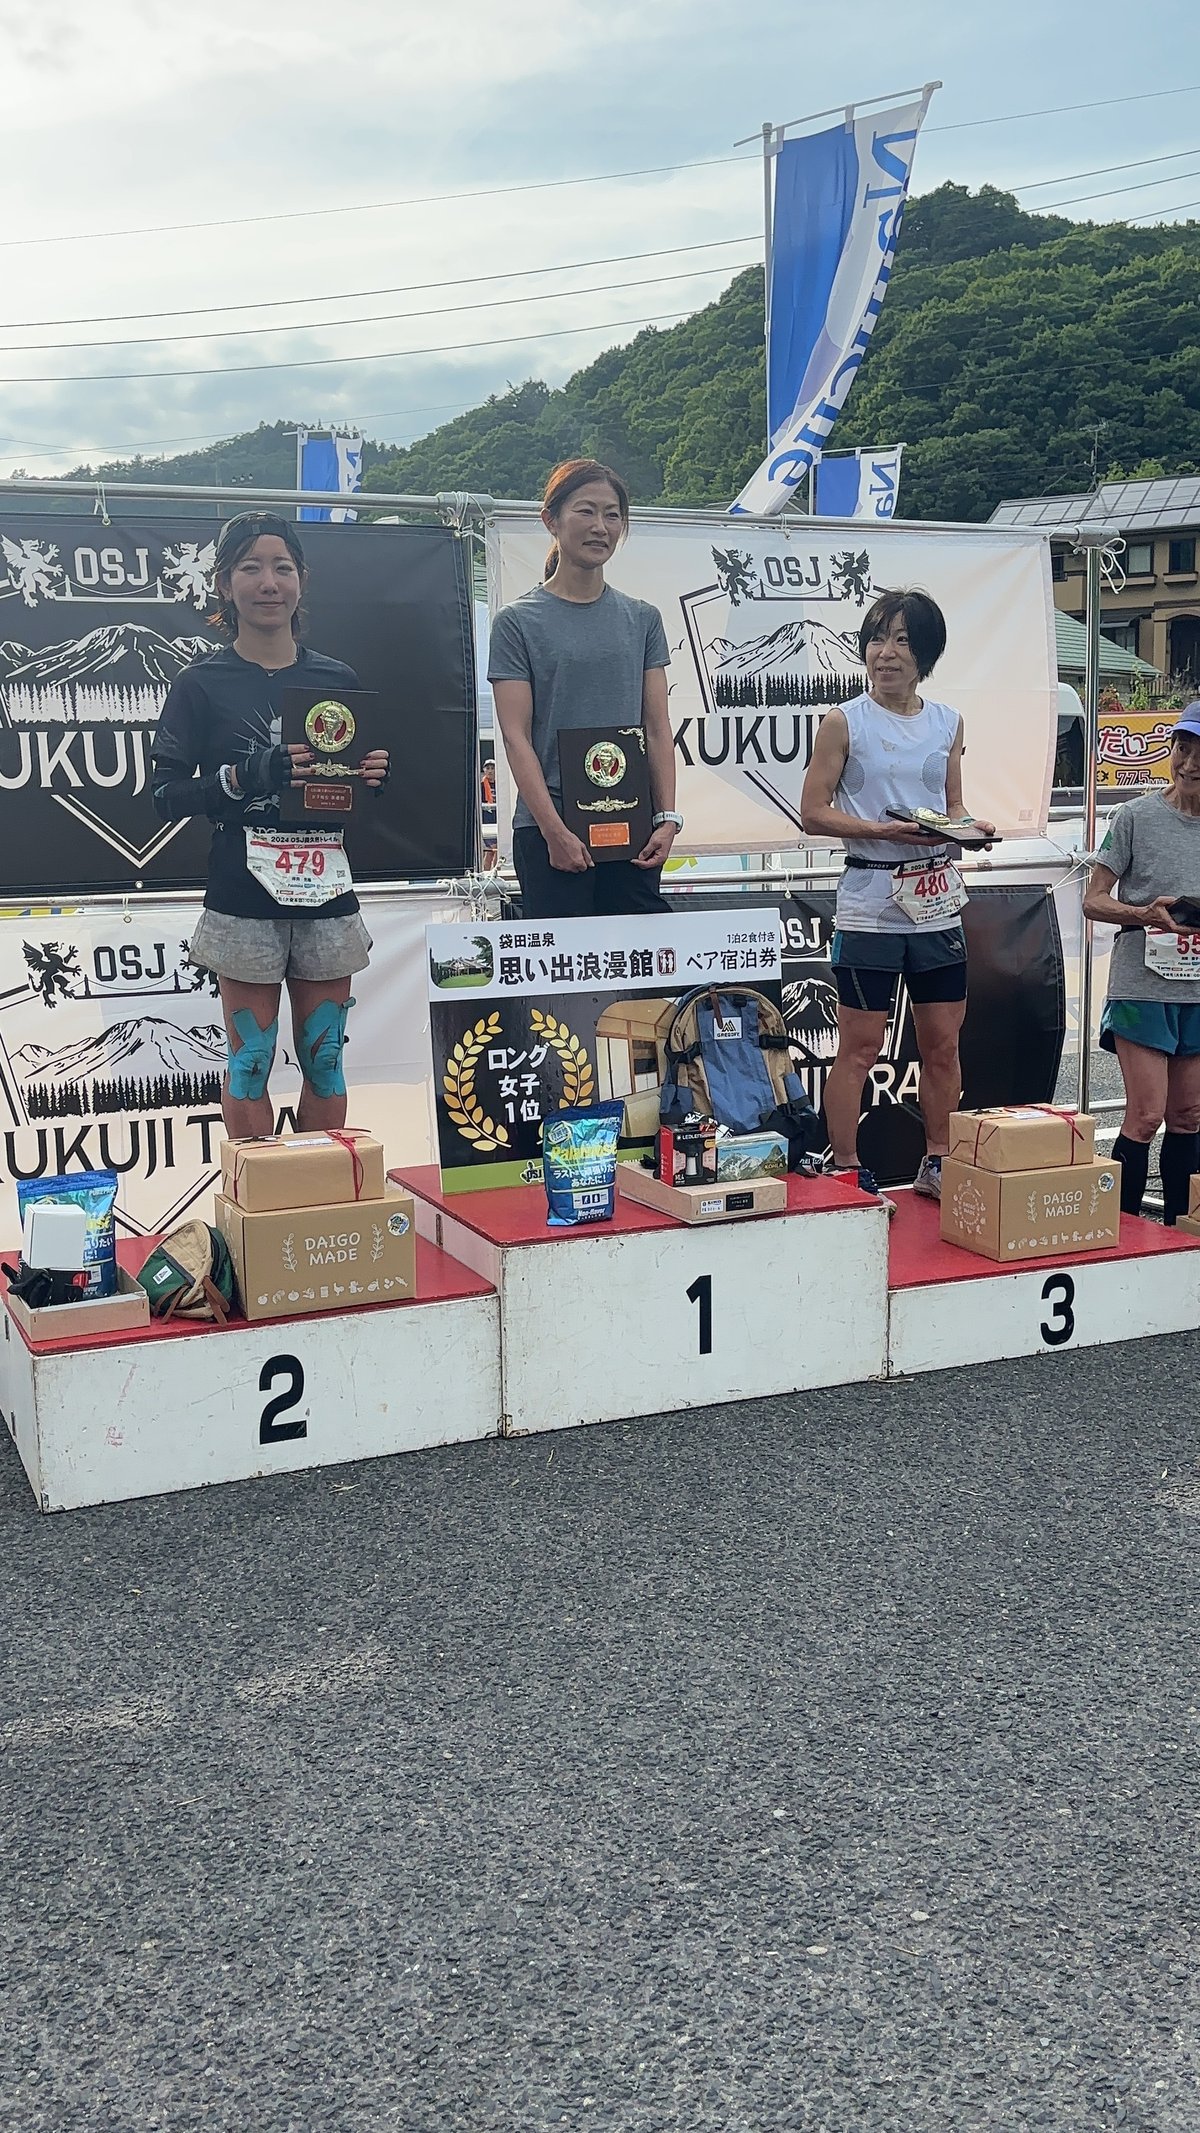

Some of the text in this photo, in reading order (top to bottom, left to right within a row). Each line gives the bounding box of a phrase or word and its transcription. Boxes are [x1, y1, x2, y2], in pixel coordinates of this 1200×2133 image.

[74, 547, 151, 586] OSJ
[764, 556, 821, 587] OSJ
[674, 714, 826, 771] KUKUJ
[275, 850, 325, 876] 479
[914, 872, 949, 897] 480
[499, 932, 555, 949] 袋田温泉
[726, 931, 776, 945] 1泊2食付き
[93, 942, 166, 981] OSJ
[498, 948, 654, 985] 思い出浪漫館
[686, 947, 778, 972] ペア宿泊券
[488, 1042, 550, 1070] ロング
[499, 1073, 540, 1098] 女子
[505, 1100, 541, 1123] 1位
[1043, 1190, 1083, 1206] DAIGO
[1045, 1203, 1080, 1218] MADE
[304, 1232, 361, 1251] DAIGO
[309, 1248, 358, 1266] MADE
[686, 1275, 712, 1355] 1
[1040, 1273, 1076, 1346] 3
[259, 1354, 308, 1445] 2
